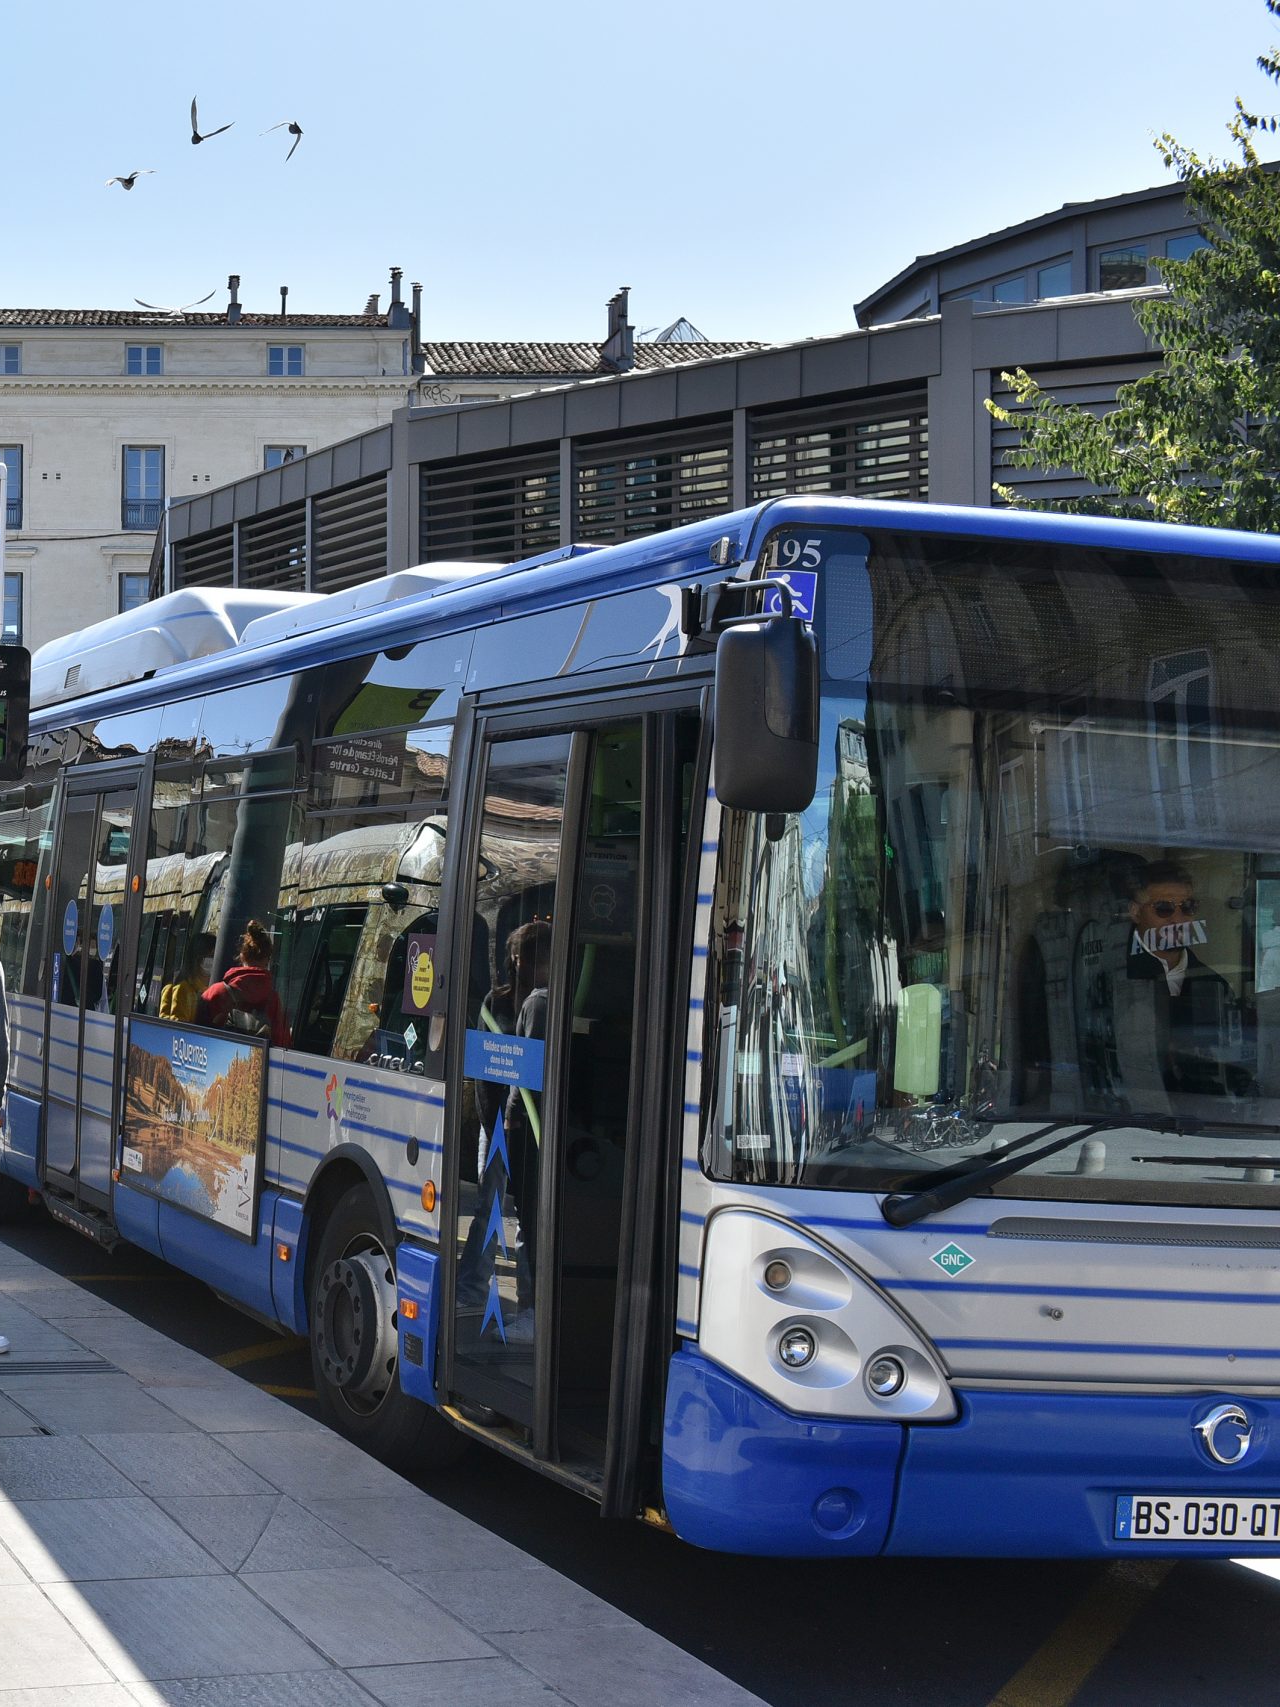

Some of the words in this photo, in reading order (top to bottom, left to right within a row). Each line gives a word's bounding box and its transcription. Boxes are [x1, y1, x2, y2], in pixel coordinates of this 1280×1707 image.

[766, 539, 821, 568] 195
[484, 1040, 499, 1052] Validez
[500, 1044, 512, 1054] votre
[513, 1045, 524, 1056] titre
[490, 1055, 500, 1064] dans
[501, 1056, 505, 1065] le
[941, 1253, 964, 1266] GNC
[1120, 1522, 1126, 1531] F
